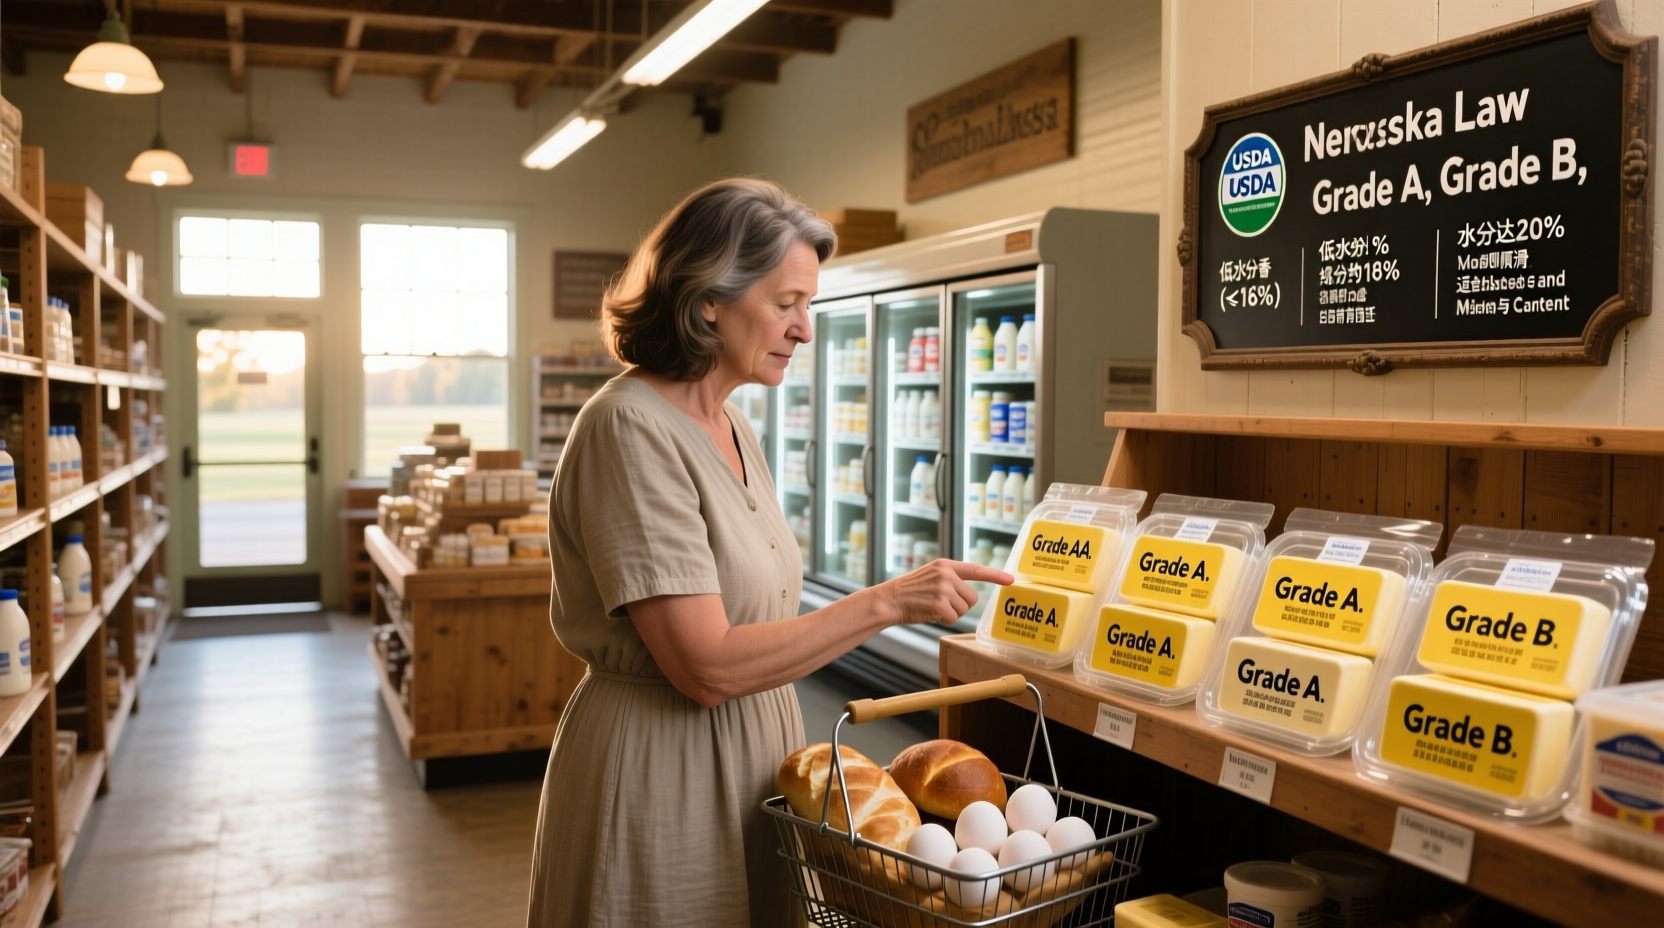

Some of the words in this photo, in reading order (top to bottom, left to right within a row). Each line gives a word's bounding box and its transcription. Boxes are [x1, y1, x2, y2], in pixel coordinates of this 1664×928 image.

[1455, 88, 1530, 132] Law
[1232, 148, 1272, 171] USDA
[1313, 170, 1393, 215] Grade
[1400, 164, 1432, 206] A,
[1440, 145, 1541, 196] Grade
[1552, 137, 1587, 186] B,
[1229, 171, 1276, 198] USDA
[1537, 269, 1566, 288] and
[1068, 539, 1092, 560] AA.
[1139, 552, 1190, 578] Grade
[1191, 560, 1209, 582] A.
[1004, 597, 1044, 623] Grade
[1045, 607, 1059, 628] A.
[1275, 576, 1338, 608] Grade
[1340, 587, 1363, 613] A.
[1107, 623, 1157, 654] Grade
[1157, 636, 1175, 660] A.
[1445, 605, 1527, 642] Grade
[1532, 618, 1559, 649] B.
[1237, 658, 1300, 696] Grade
[1302, 675, 1325, 703] A.
[1403, 703, 1486, 749] Grade
[1490, 724, 1517, 759] B.
